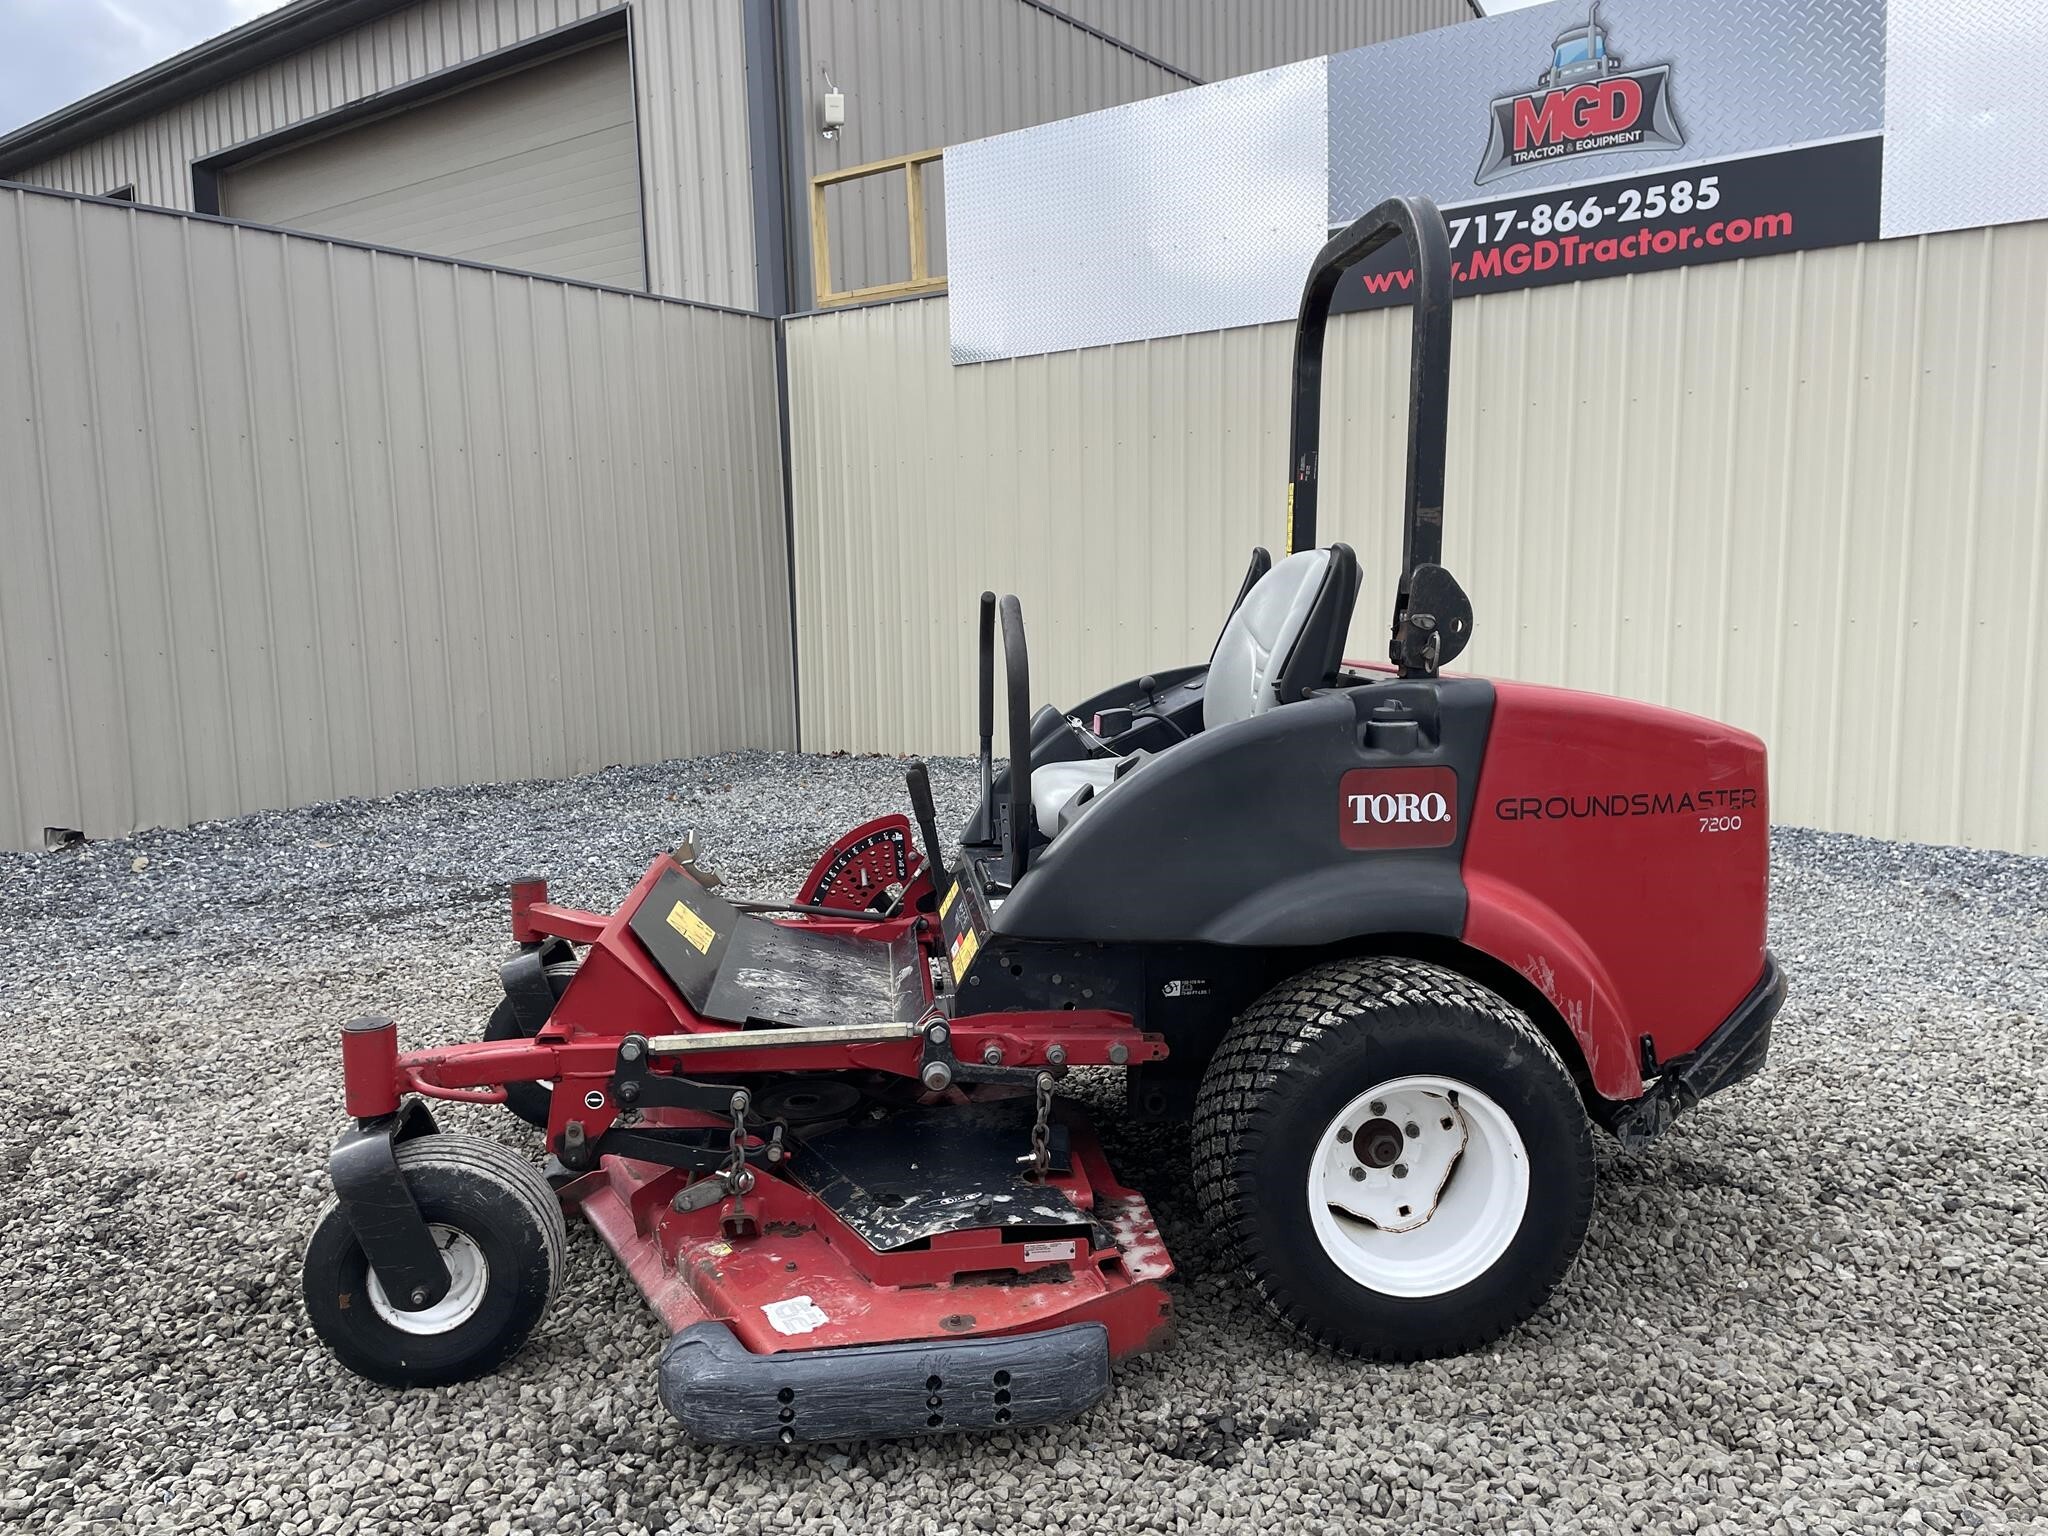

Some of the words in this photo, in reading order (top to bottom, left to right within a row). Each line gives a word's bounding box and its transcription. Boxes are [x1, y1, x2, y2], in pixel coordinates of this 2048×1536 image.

[1513, 78, 1642, 151] MGD
[1514, 144, 1565, 163] TRACTOR
[1575, 130, 1642, 151] EQUIPMENT
[1449, 176, 1720, 248] 717-866-2585
[1363, 212, 1792, 294] ww.MGDTractor.com
[1496, 788, 1757, 820] GROUNDSMASTER
[1699, 816, 1742, 832] 7200
